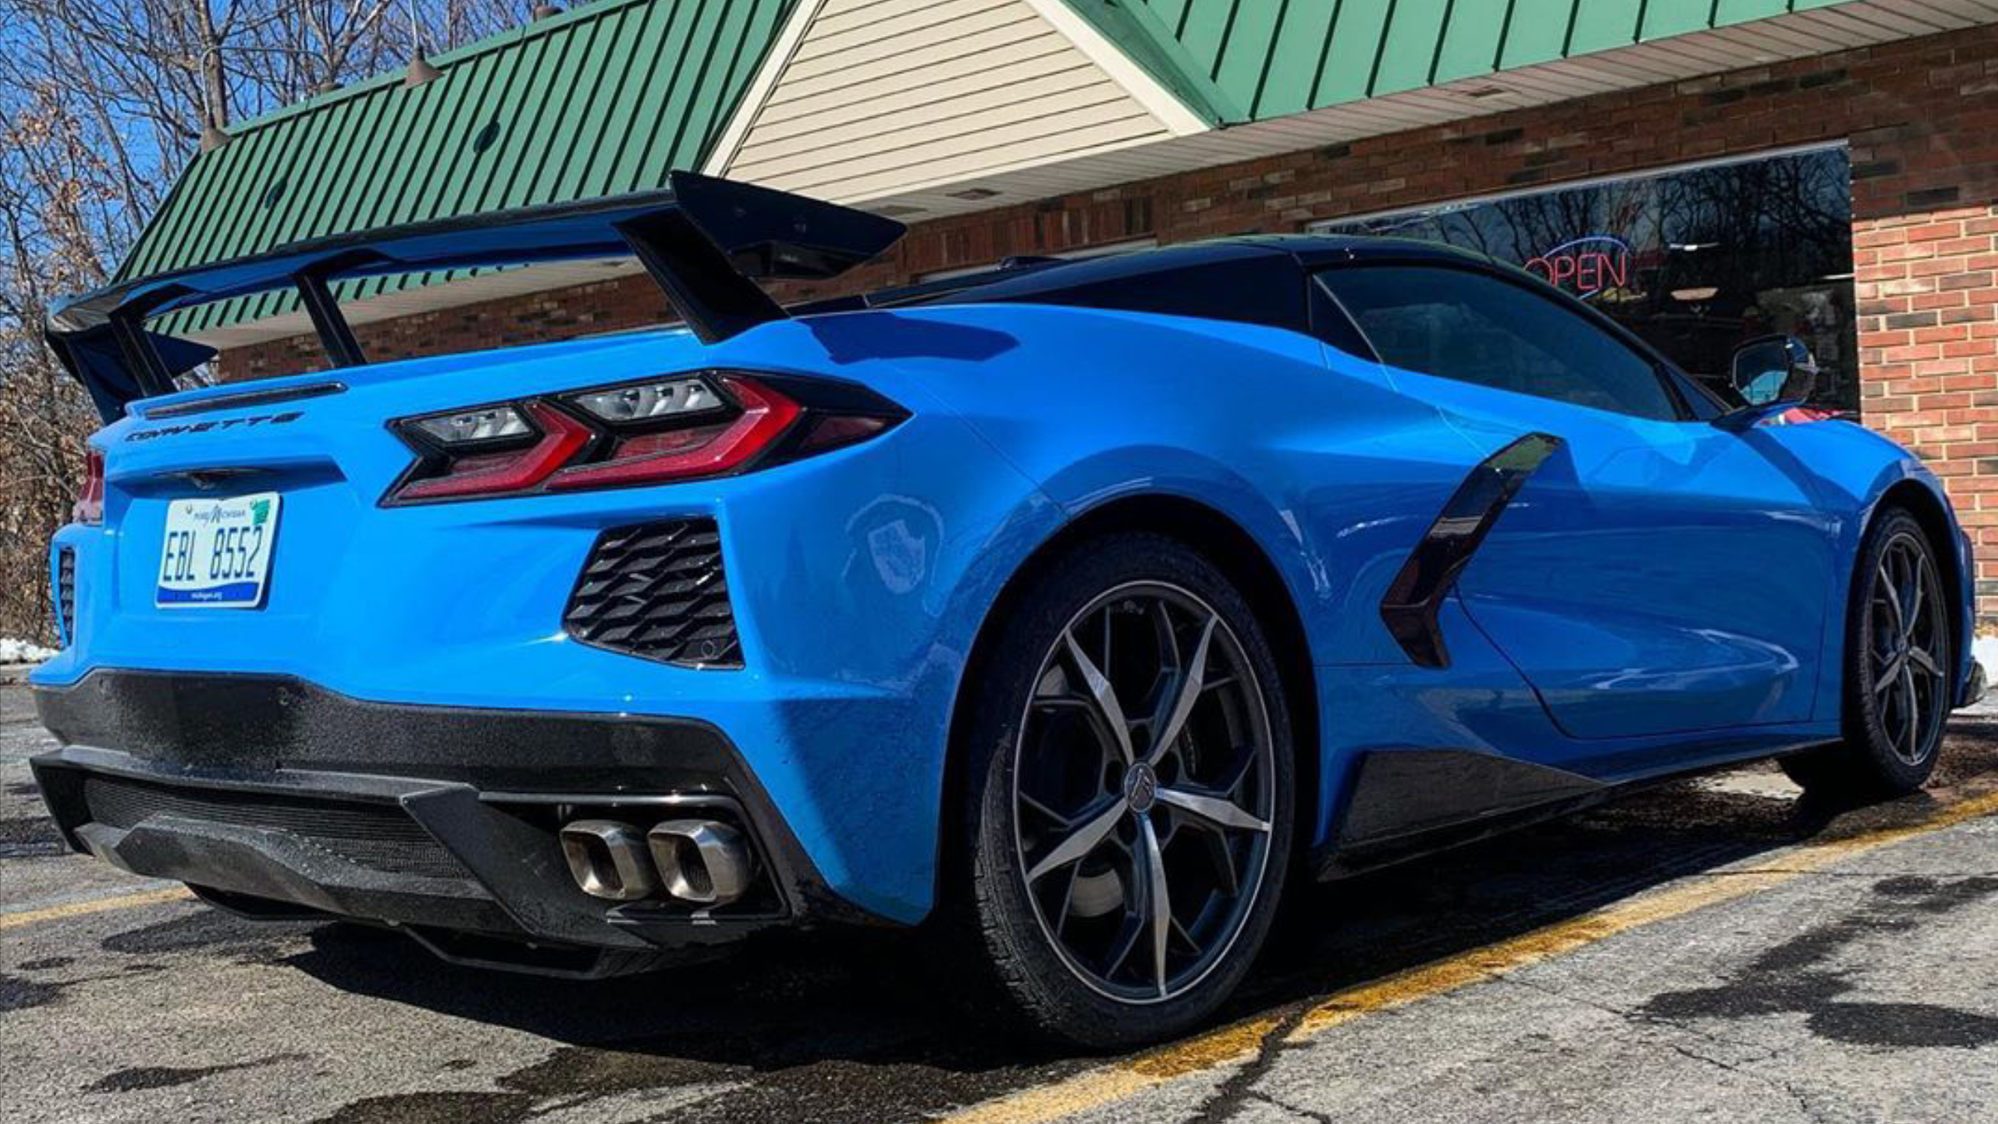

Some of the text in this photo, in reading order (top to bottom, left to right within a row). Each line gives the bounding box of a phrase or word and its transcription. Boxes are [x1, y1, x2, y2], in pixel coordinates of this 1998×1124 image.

[1523, 253, 1626, 290] OPEN
[163, 526, 263, 582] EBL 8552
